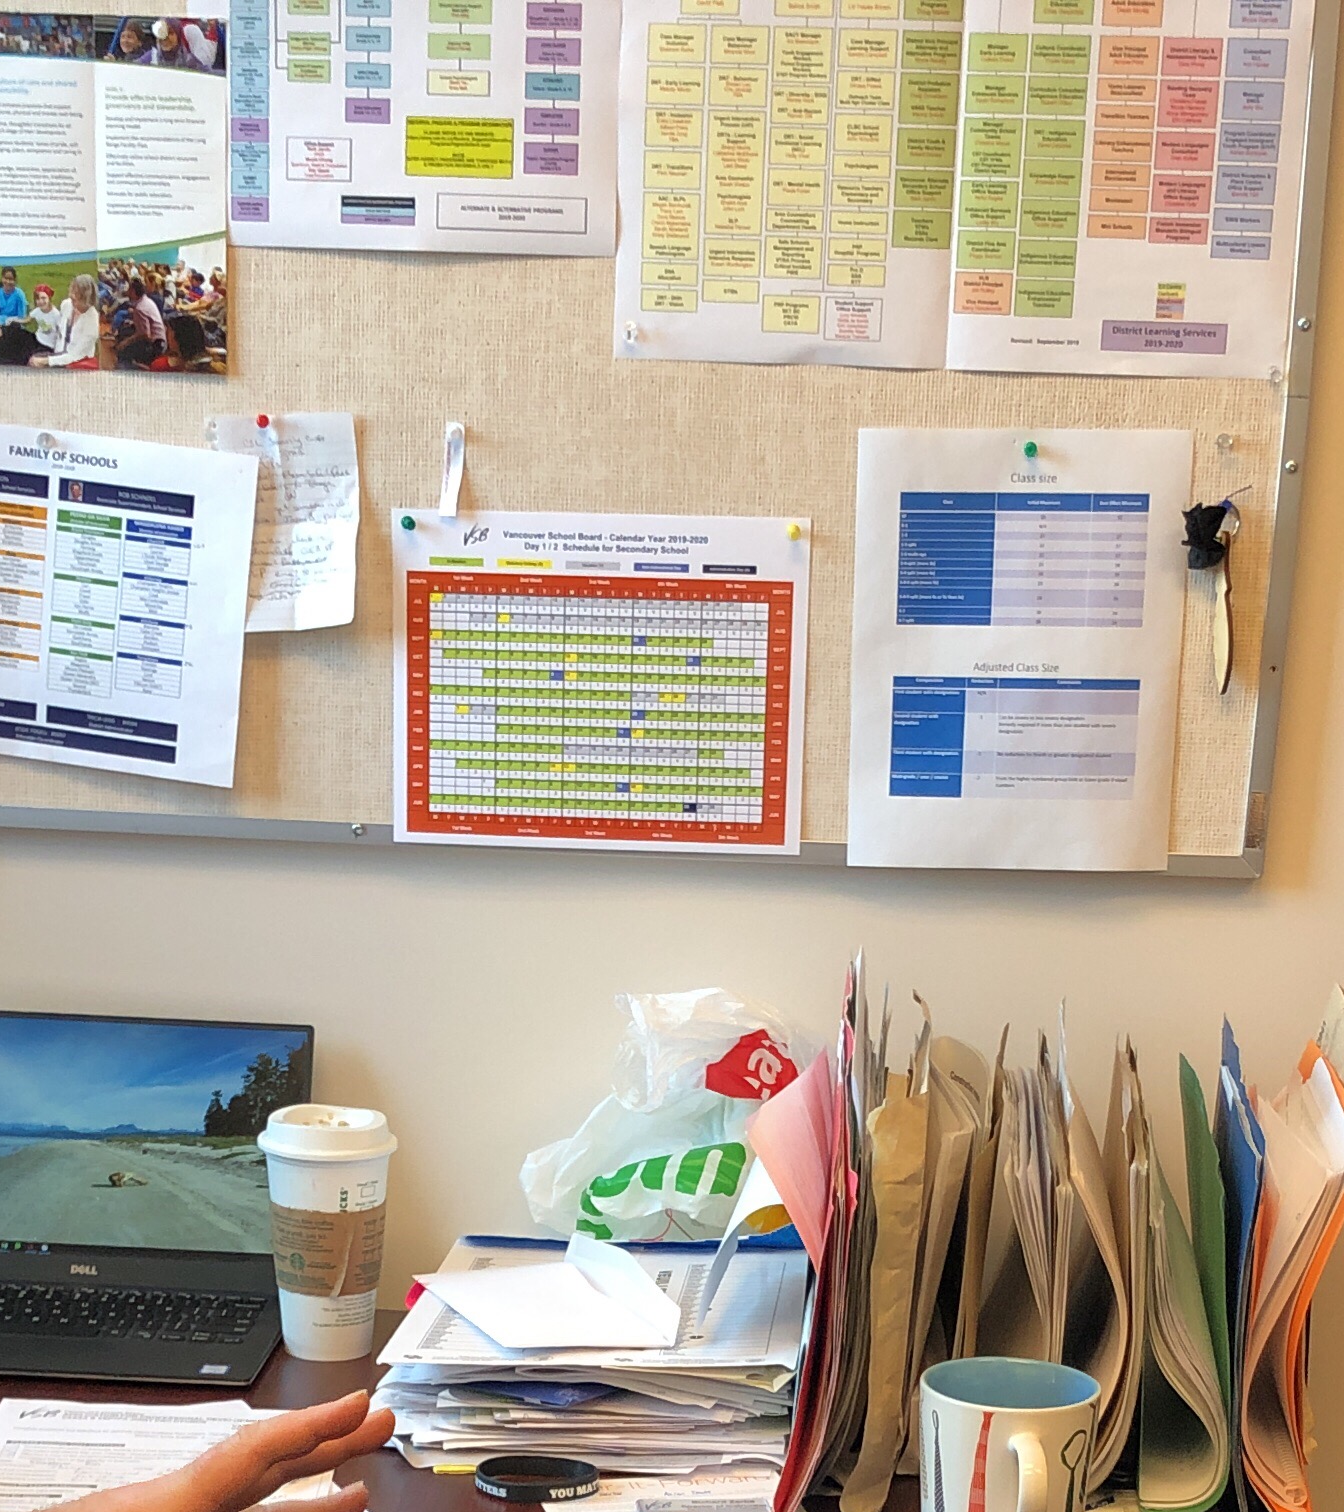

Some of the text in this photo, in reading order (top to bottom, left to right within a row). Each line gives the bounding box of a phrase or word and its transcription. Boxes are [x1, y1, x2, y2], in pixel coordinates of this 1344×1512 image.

[1112, 326, 1217, 338] District Learning Services
[1144, 340, 1183, 348] 2019-2020
[9, 445, 119, 470] FAMILY OF SCHOOLS
[1010, 473, 1058, 484] Class size
[503, 530, 546, 540] Vancouver
[548, 531, 576, 541] School
[578, 532, 603, 542] Board
[609, 533, 645, 543] Calendar
[647, 535, 666, 544] Year
[668, 535, 709, 544] 2019-2020
[524, 542, 540, 552] Day
[562, 544, 600, 553] Schedule
[602, 545, 613, 553] for
[616, 545, 658, 555] Secondary
[661, 546, 689, 555] School
[973, 662, 1059, 673] Adjusted Class Size
[70, 1264, 98, 1275] DELL
[549, 1488, 574, 1499] YOU
